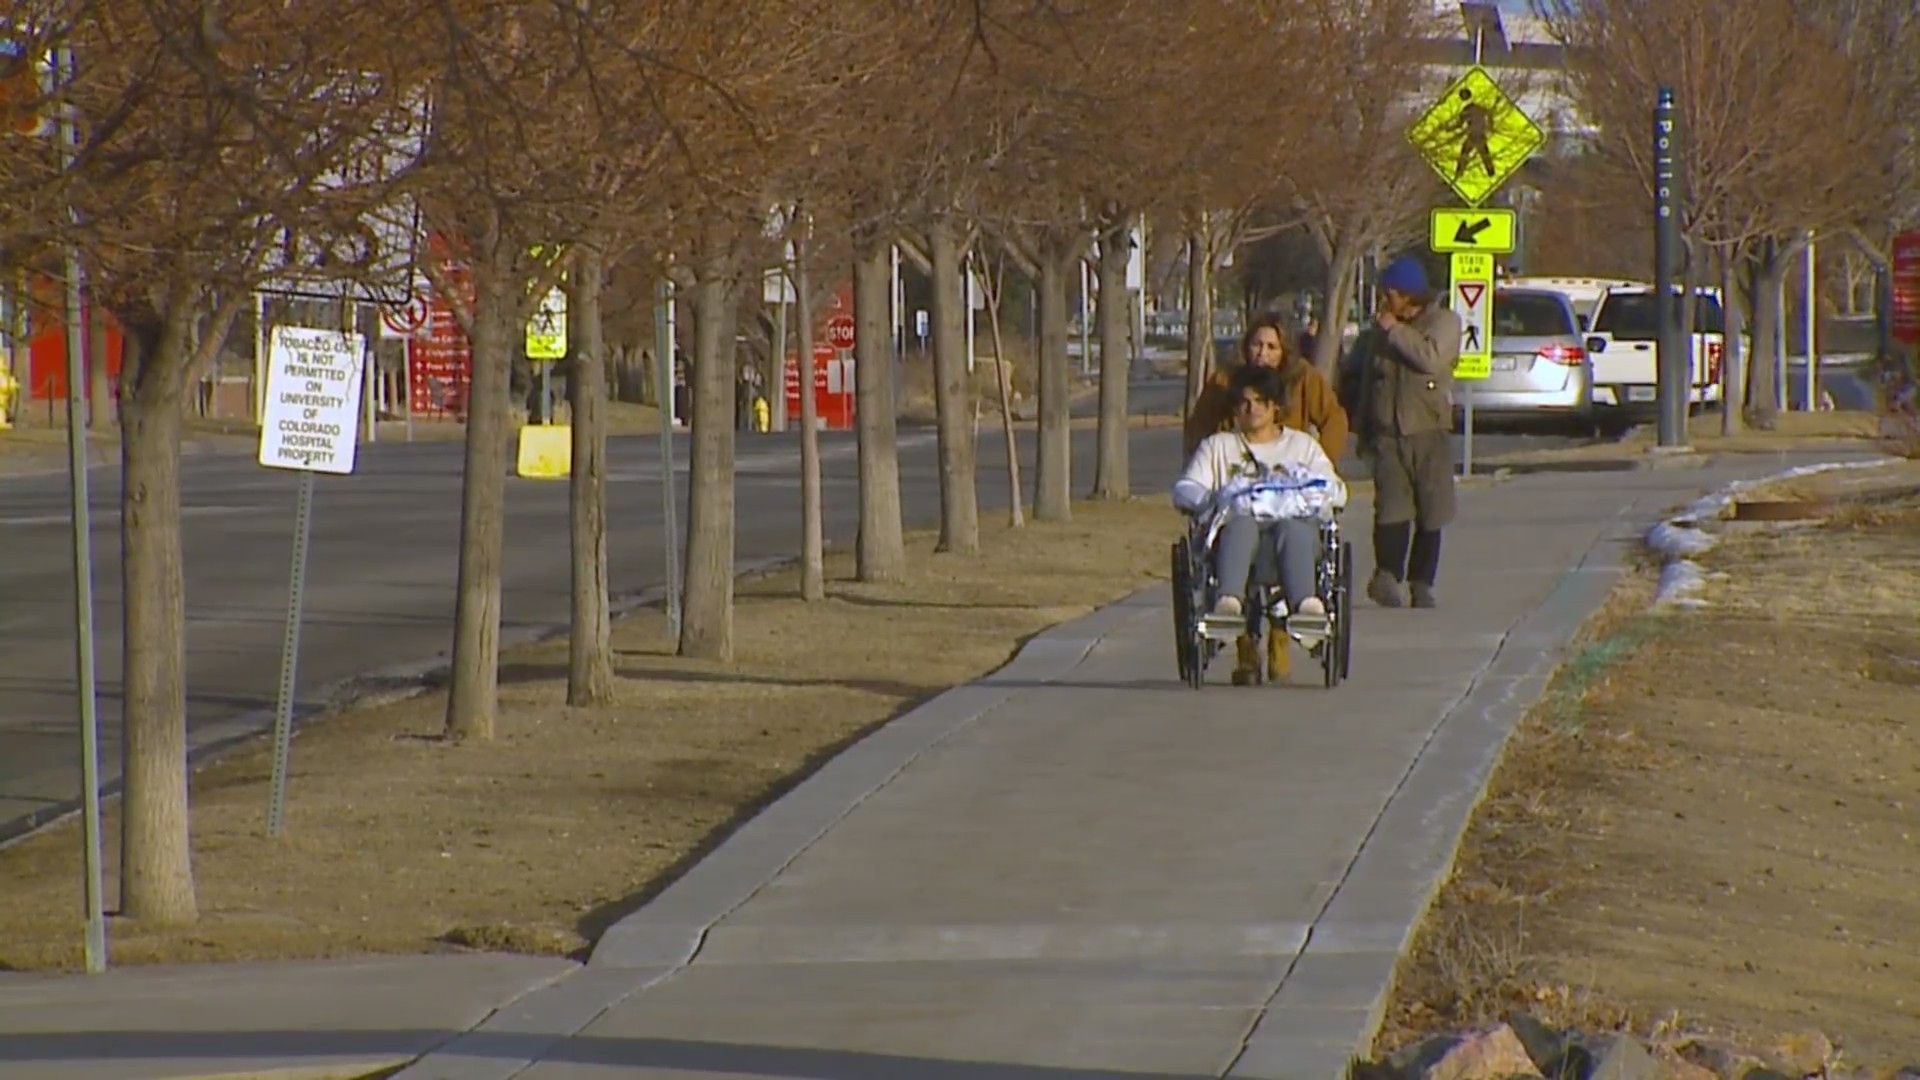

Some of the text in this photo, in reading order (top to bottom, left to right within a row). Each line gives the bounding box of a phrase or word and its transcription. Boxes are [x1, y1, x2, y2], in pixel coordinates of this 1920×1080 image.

[1659, 120, 1673, 217] Police
[1458, 256, 1485, 265] STATE
[1461, 266, 1481, 274] LAW
[279, 336, 332, 351] TOBACCO
[297, 352, 335, 366] IS NOT
[284, 364, 346, 381] PERMITTED
[305, 381, 322, 392] ON
[280, 392, 344, 409] UNIVERSITY
[303, 408, 319, 419] OF
[278, 420, 341, 436] COLORADO
[282, 434, 334, 449] HOSPITAL
[277, 447, 335, 463] PROPERTY
